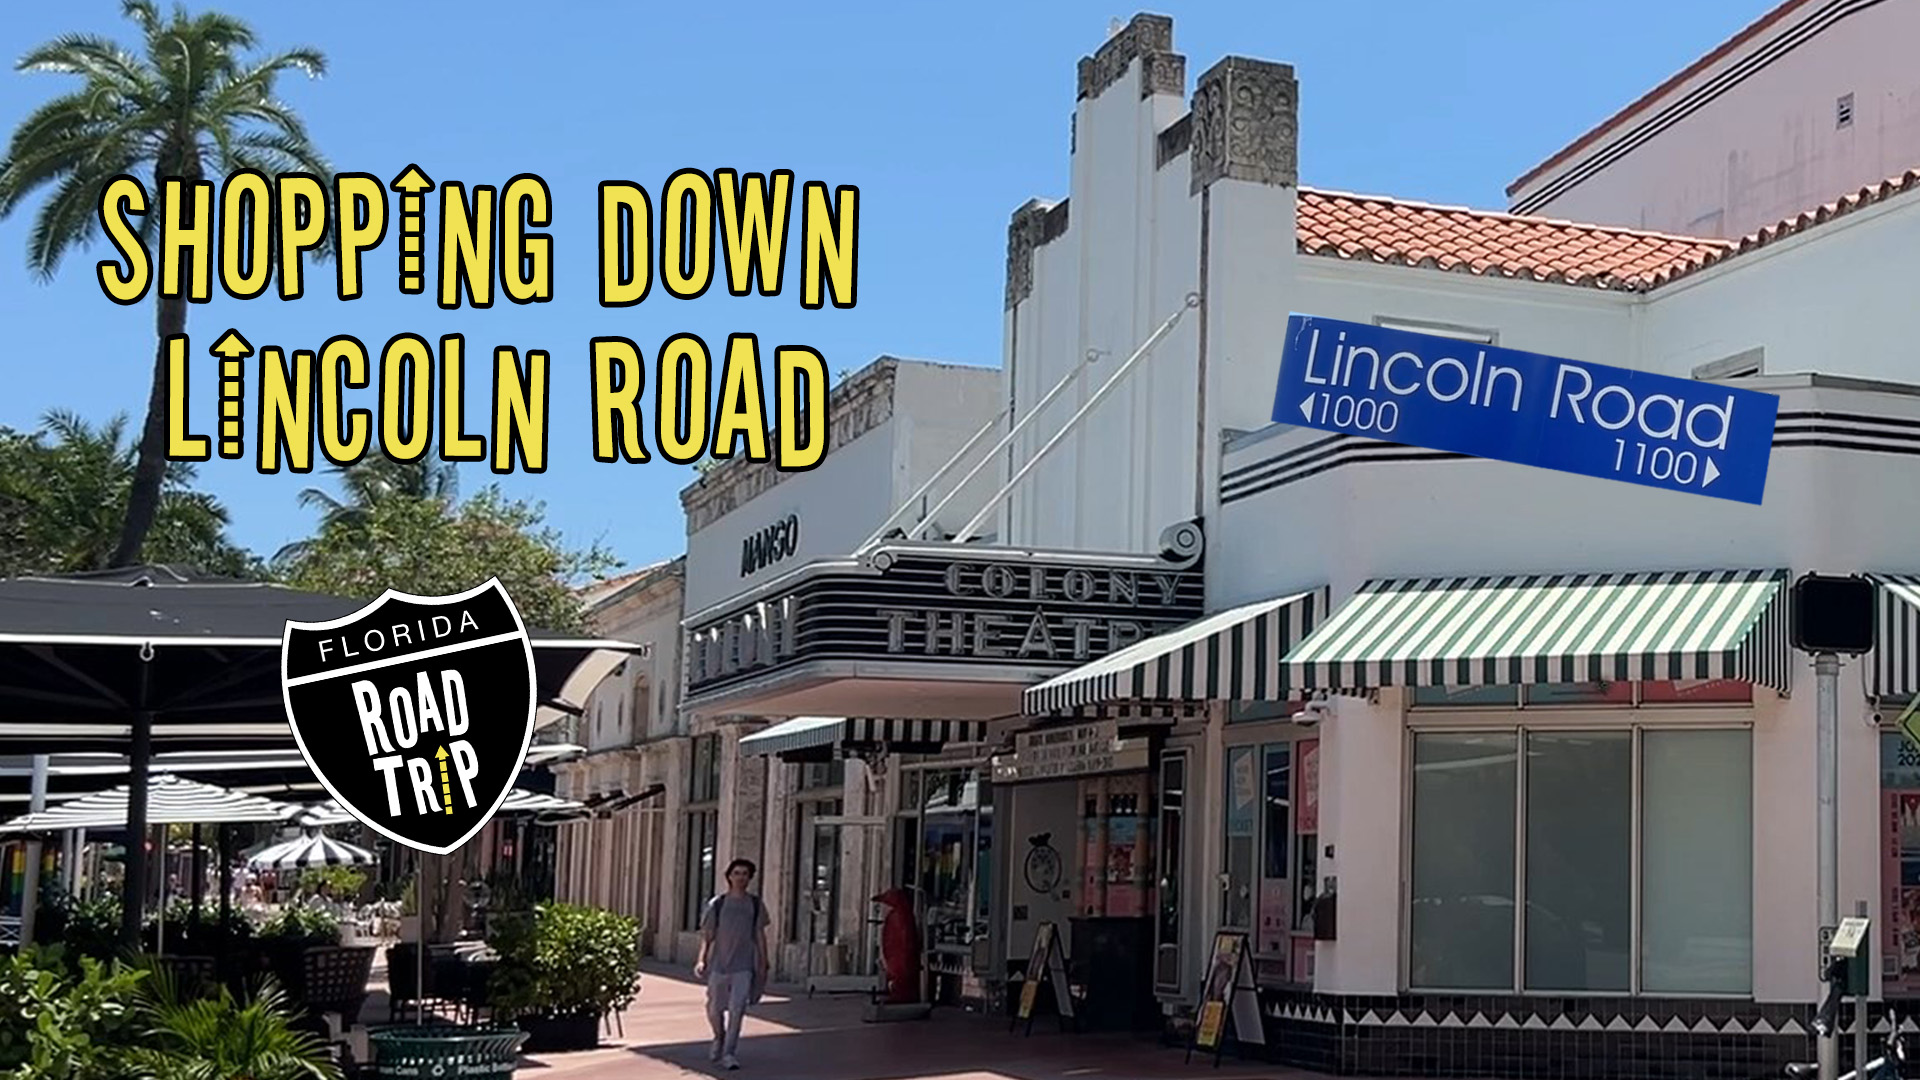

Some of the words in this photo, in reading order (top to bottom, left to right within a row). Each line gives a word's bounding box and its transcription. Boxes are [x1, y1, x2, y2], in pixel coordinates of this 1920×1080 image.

[1303, 328, 1524, 412] Lincoln
[1549, 363, 1735, 451] Road
[1319, 393, 1399, 434] 1000
[1613, 437, 1697, 486] 1100
[740, 514, 799, 578] MANGO
[944, 562, 1183, 608] COLONY
[876, 604, 1191, 660] THEATR
